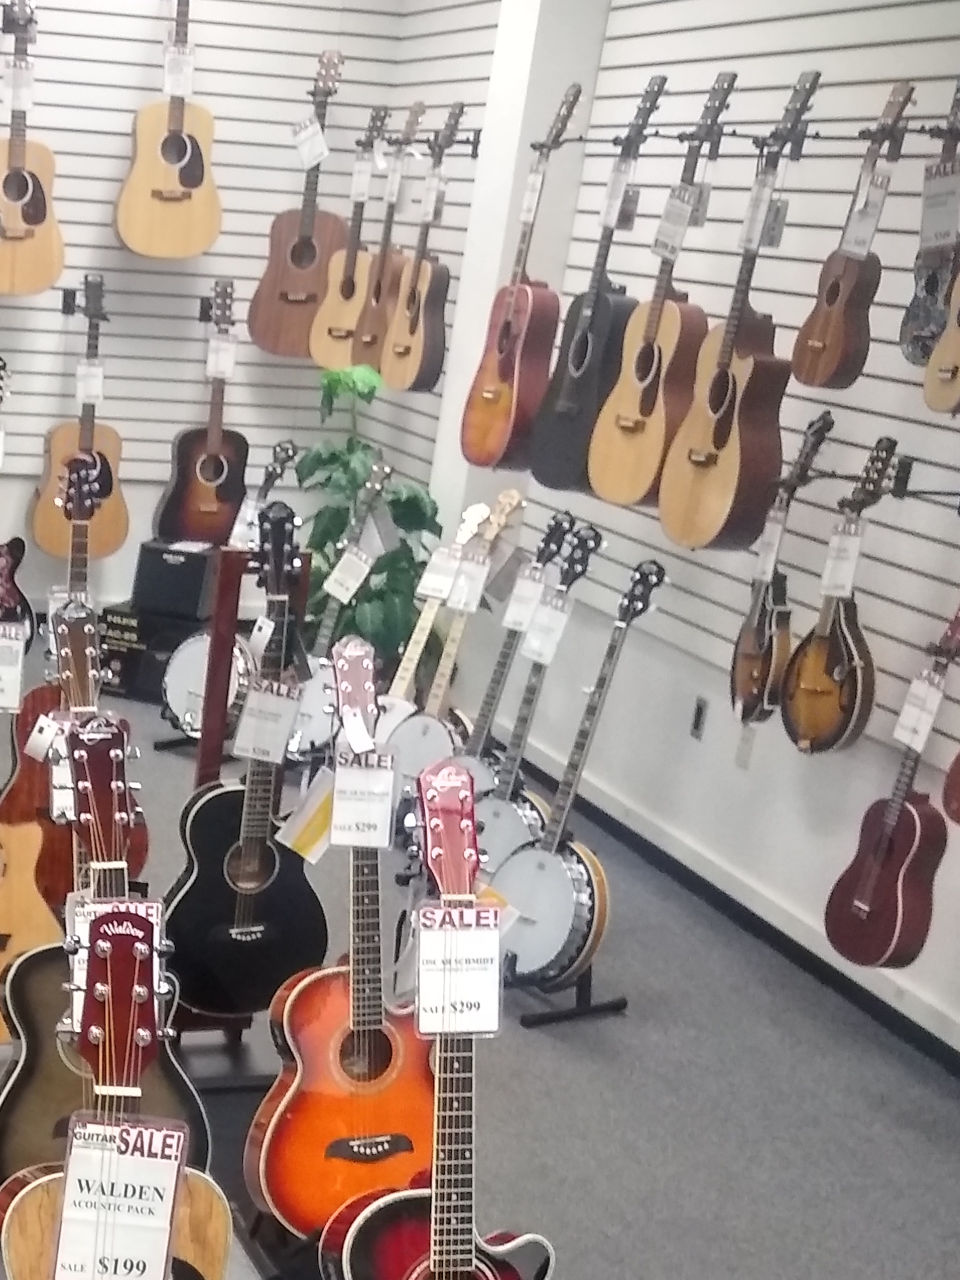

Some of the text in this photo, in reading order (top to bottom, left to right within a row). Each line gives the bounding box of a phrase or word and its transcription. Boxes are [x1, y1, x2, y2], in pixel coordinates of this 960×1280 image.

[421, 909, 499, 929] SALE!
[100, 920, 146, 939] Walden
[450, 1000, 482, 1014] $299
[74, 1130, 117, 1144] GUITAR
[117, 1128, 183, 1161] SALE!
[77, 1177, 167, 1202] WALDEN
[71, 1199, 156, 1217] ACOUSTIC PACK
[60, 1256, 148, 1278] SALE $199
